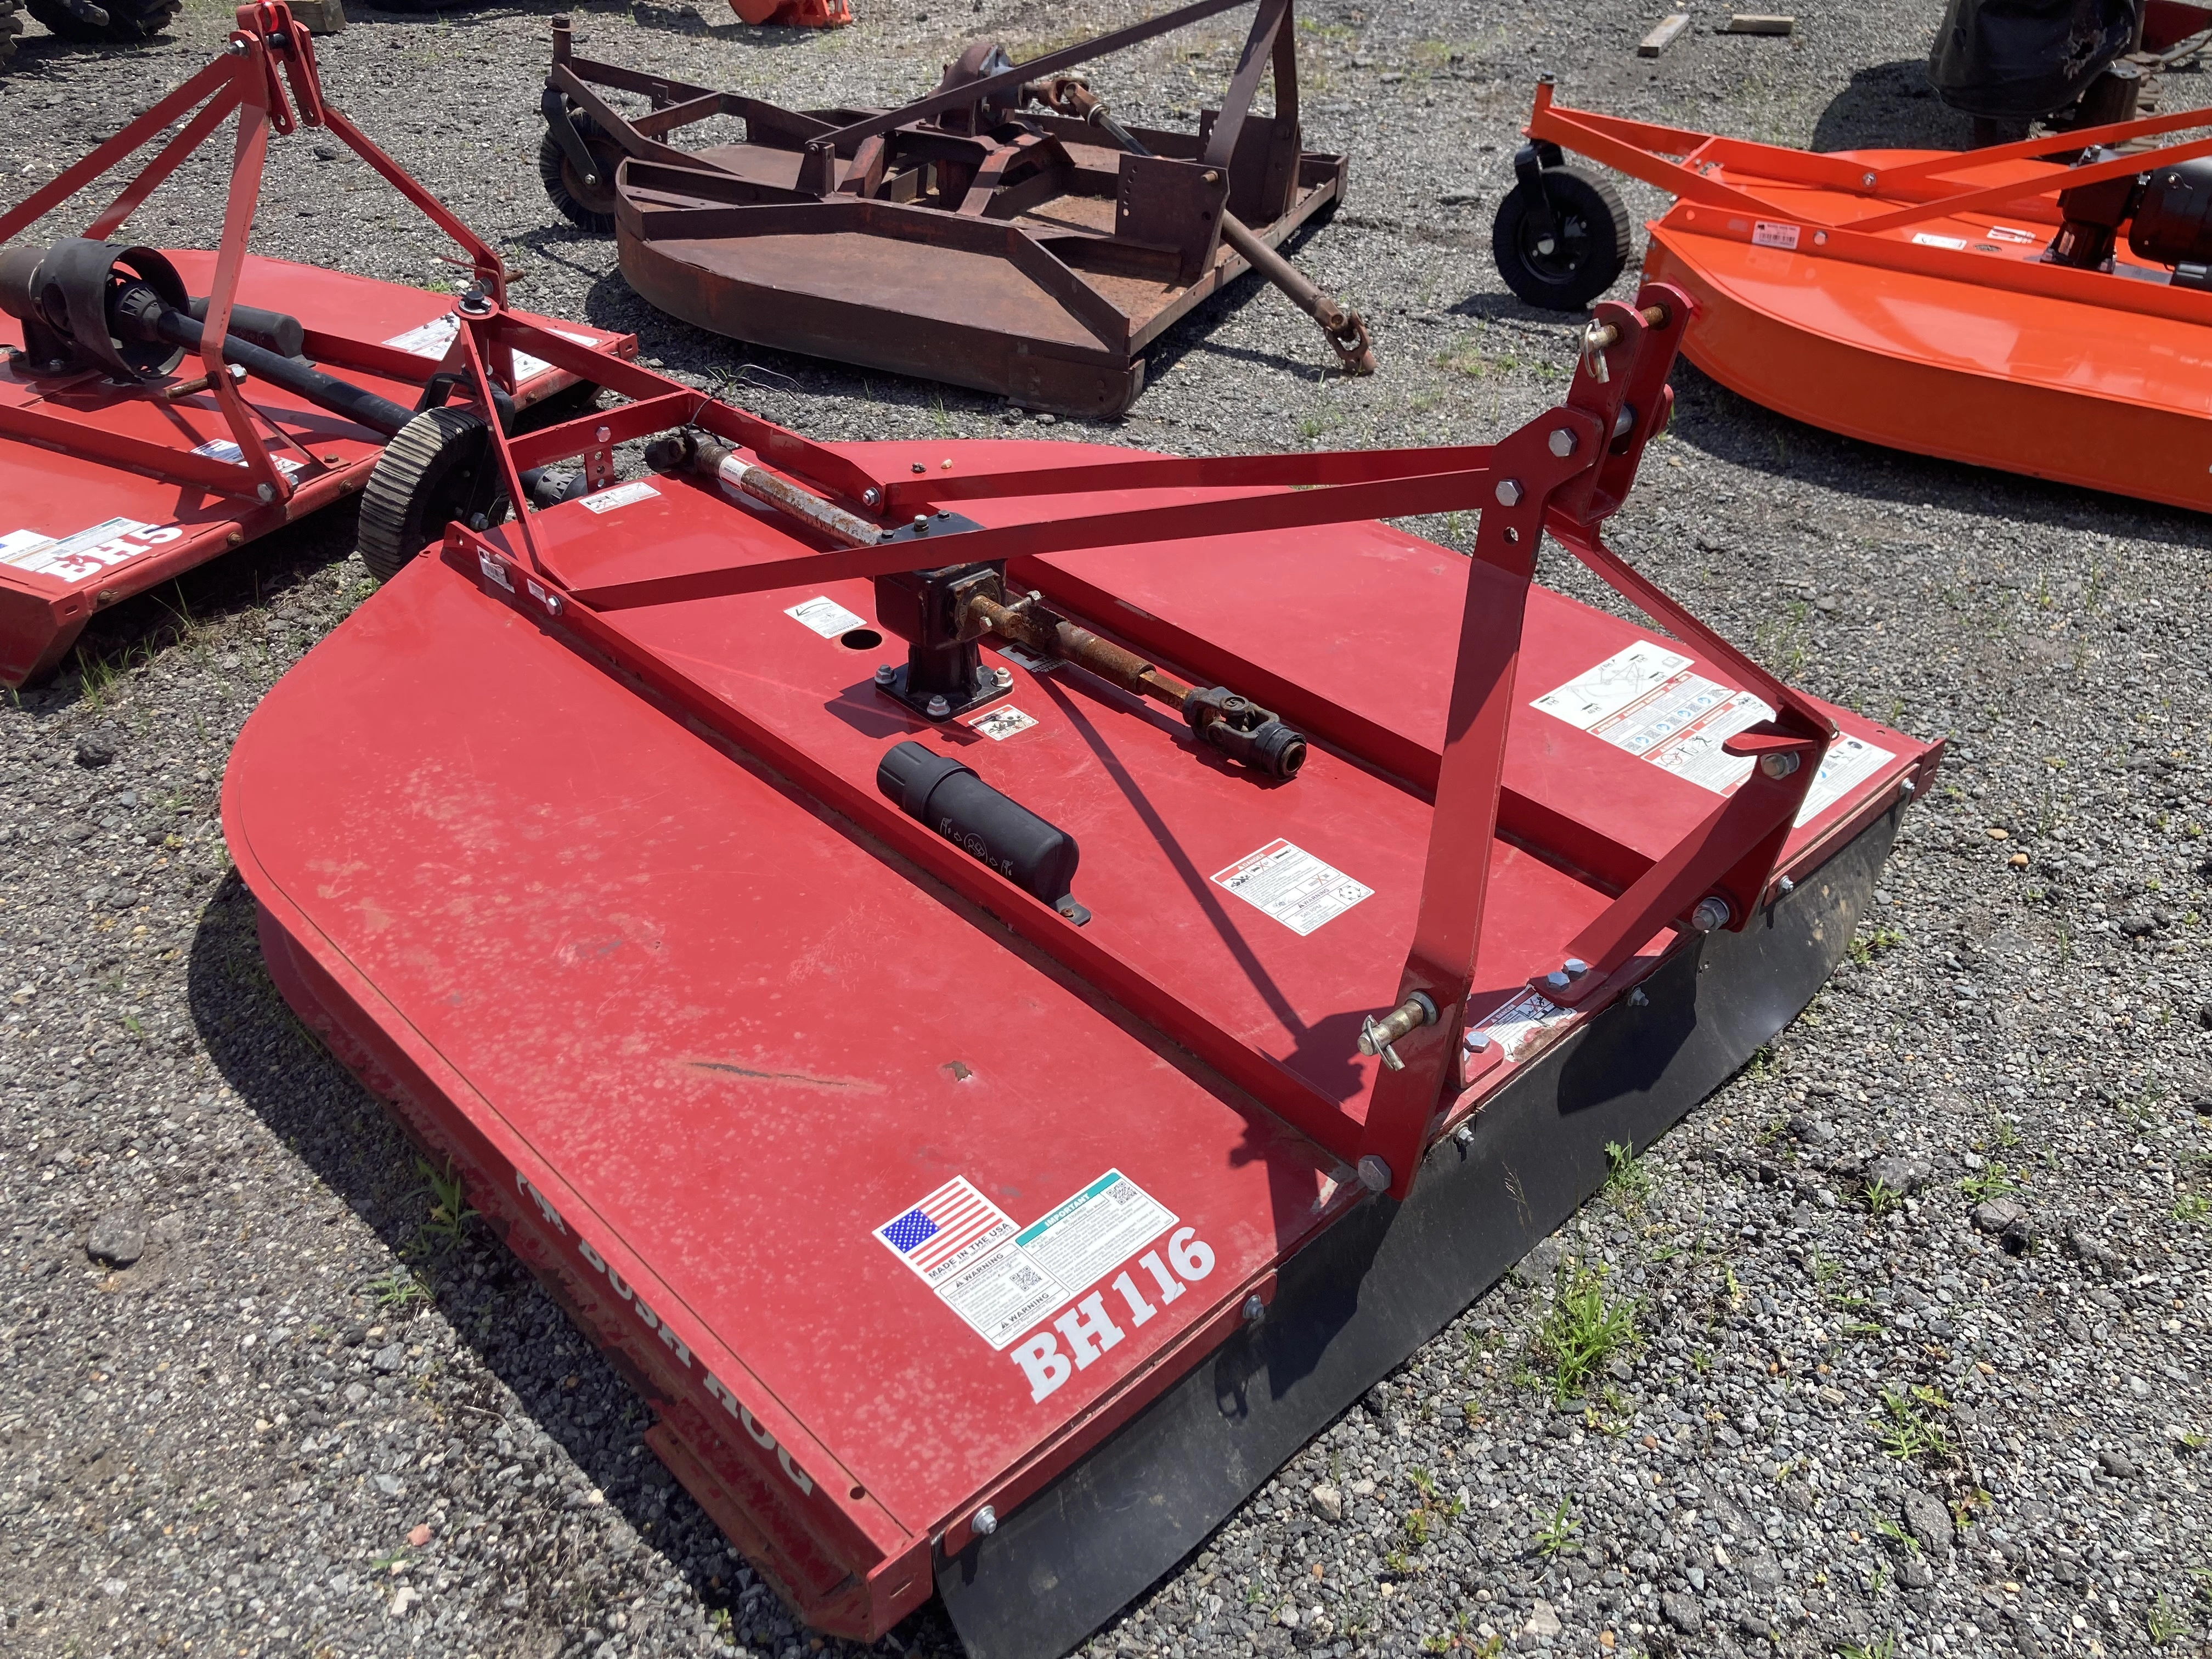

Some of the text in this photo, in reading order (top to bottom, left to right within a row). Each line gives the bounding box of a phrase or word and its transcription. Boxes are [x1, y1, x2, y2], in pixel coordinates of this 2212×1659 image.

[1242, 853, 1266, 867] DANGER
[1301, 888, 1330, 905] WARNING
[1495, 1002, 1516, 1019] DANGER
[1043, 1193, 1092, 1227] IMPORTANT
[928, 1257, 957, 1278] MADE
[956, 1249, 969, 1259] IN
[968, 1235, 989, 1251] THE
[988, 1221, 1010, 1237] USA
[958, 1255, 970, 1264] AND
[969, 1237, 996, 1256] IMPORTED
[996, 1226, 1013, 1238] PARTS
[962, 1252, 1005, 1281] WARNING
[1007, 1292, 1050, 1322] WARNING
[1010, 1227, 1216, 1404] BH116
